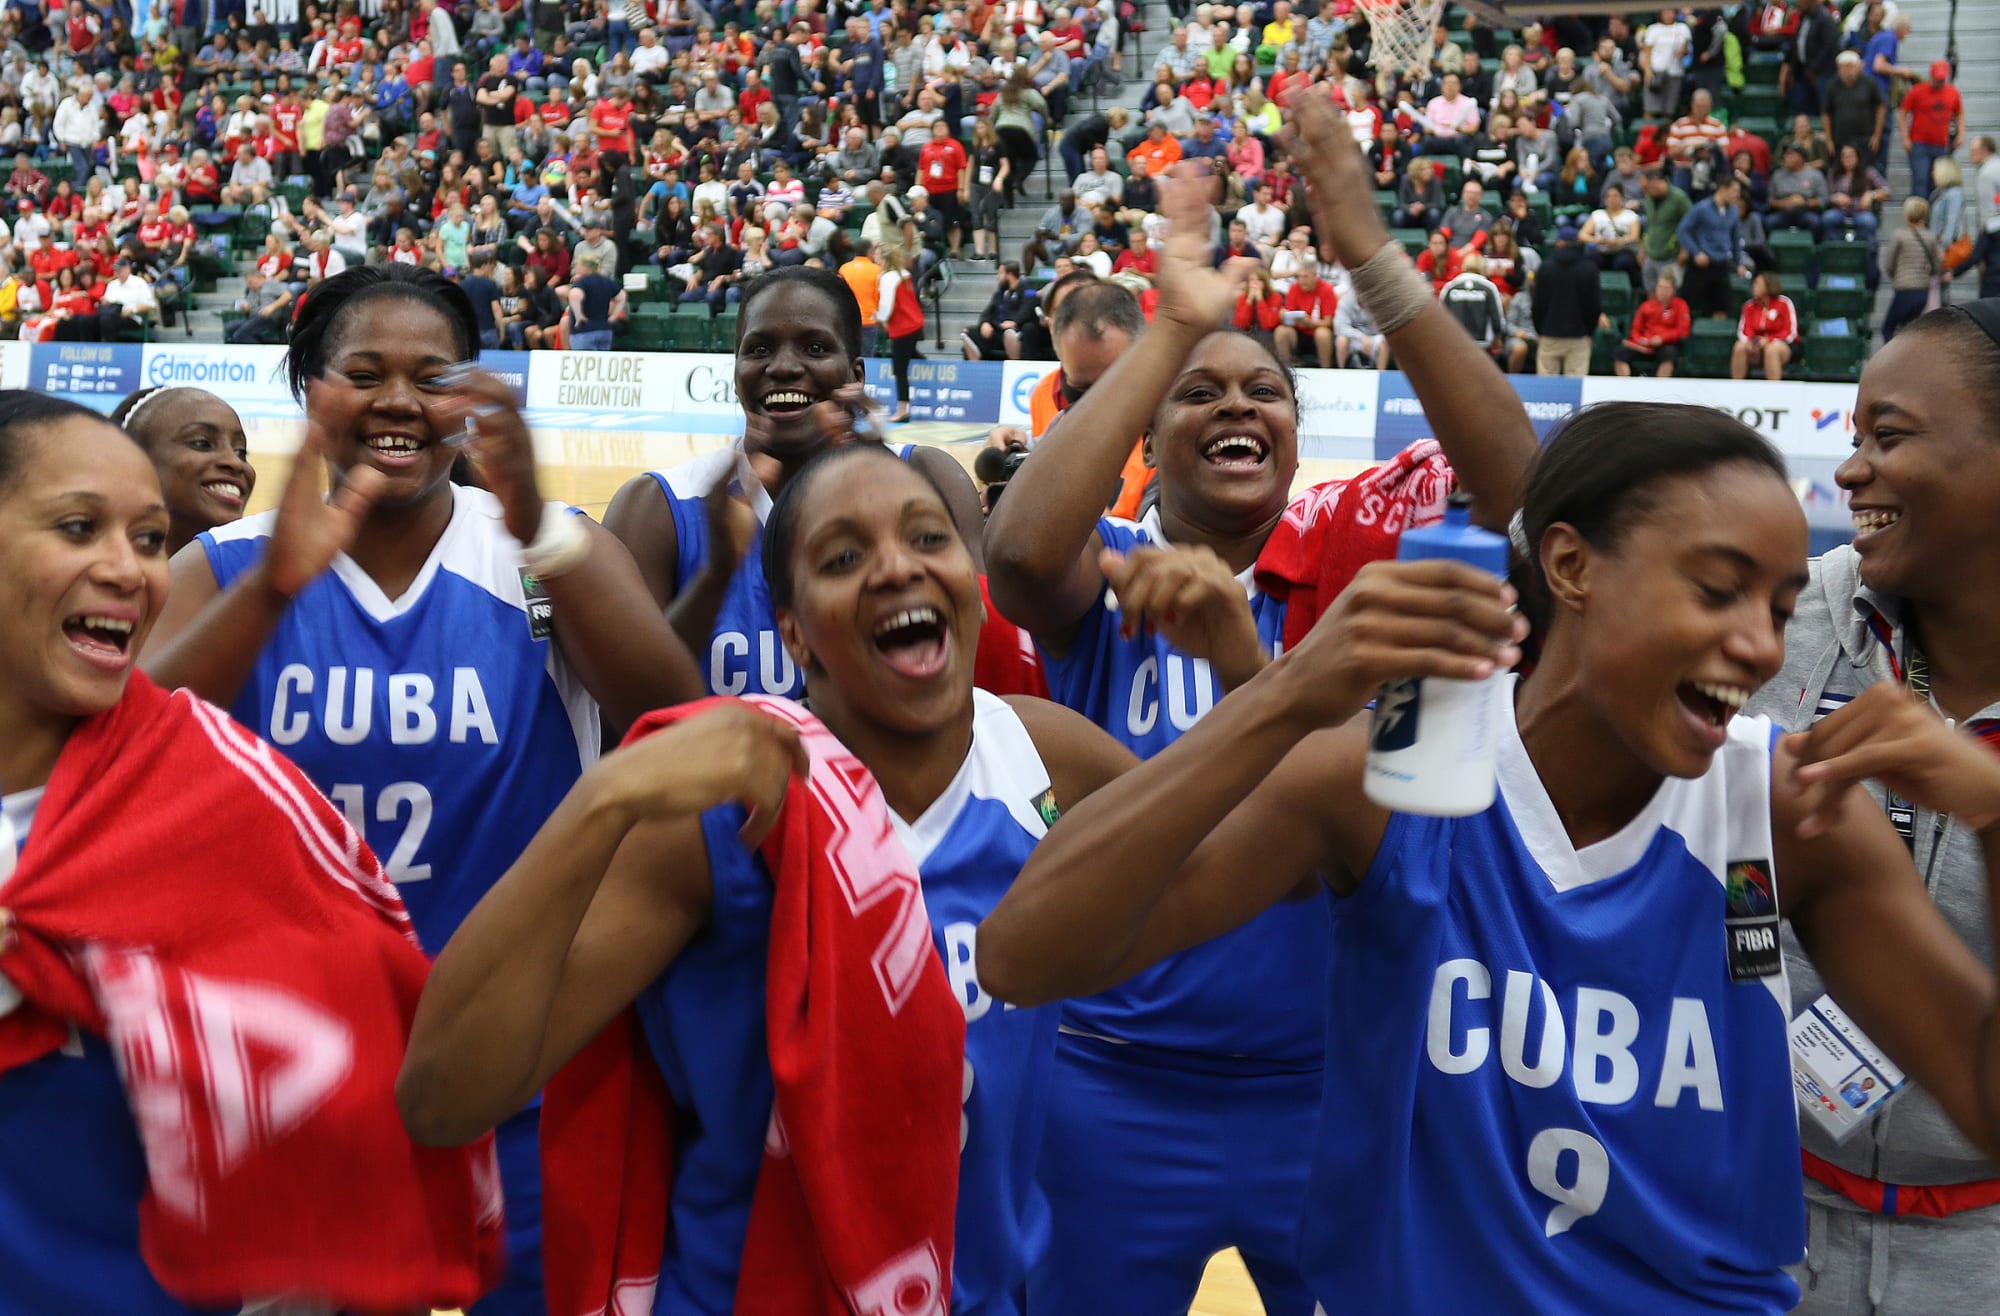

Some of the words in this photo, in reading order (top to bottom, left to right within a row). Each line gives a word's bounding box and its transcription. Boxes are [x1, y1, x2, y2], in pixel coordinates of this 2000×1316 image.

[149, 353, 255, 386] Edmonton
[560, 356, 643, 383] EXPLORE
[686, 365, 740, 404] Ca
[938, 364, 958, 381] US
[558, 384, 641, 407] EDMONTON
[531, 604, 552, 620] FIB
[711, 630, 805, 697] CU
[270, 663, 499, 745] CUBA
[1127, 654, 1214, 736] CU
[331, 781, 433, 884] 12
[1735, 927, 1776, 953] FIBA
[1427, 958, 1724, 1113] CUBA
[1527, 1127, 1610, 1239] 9
